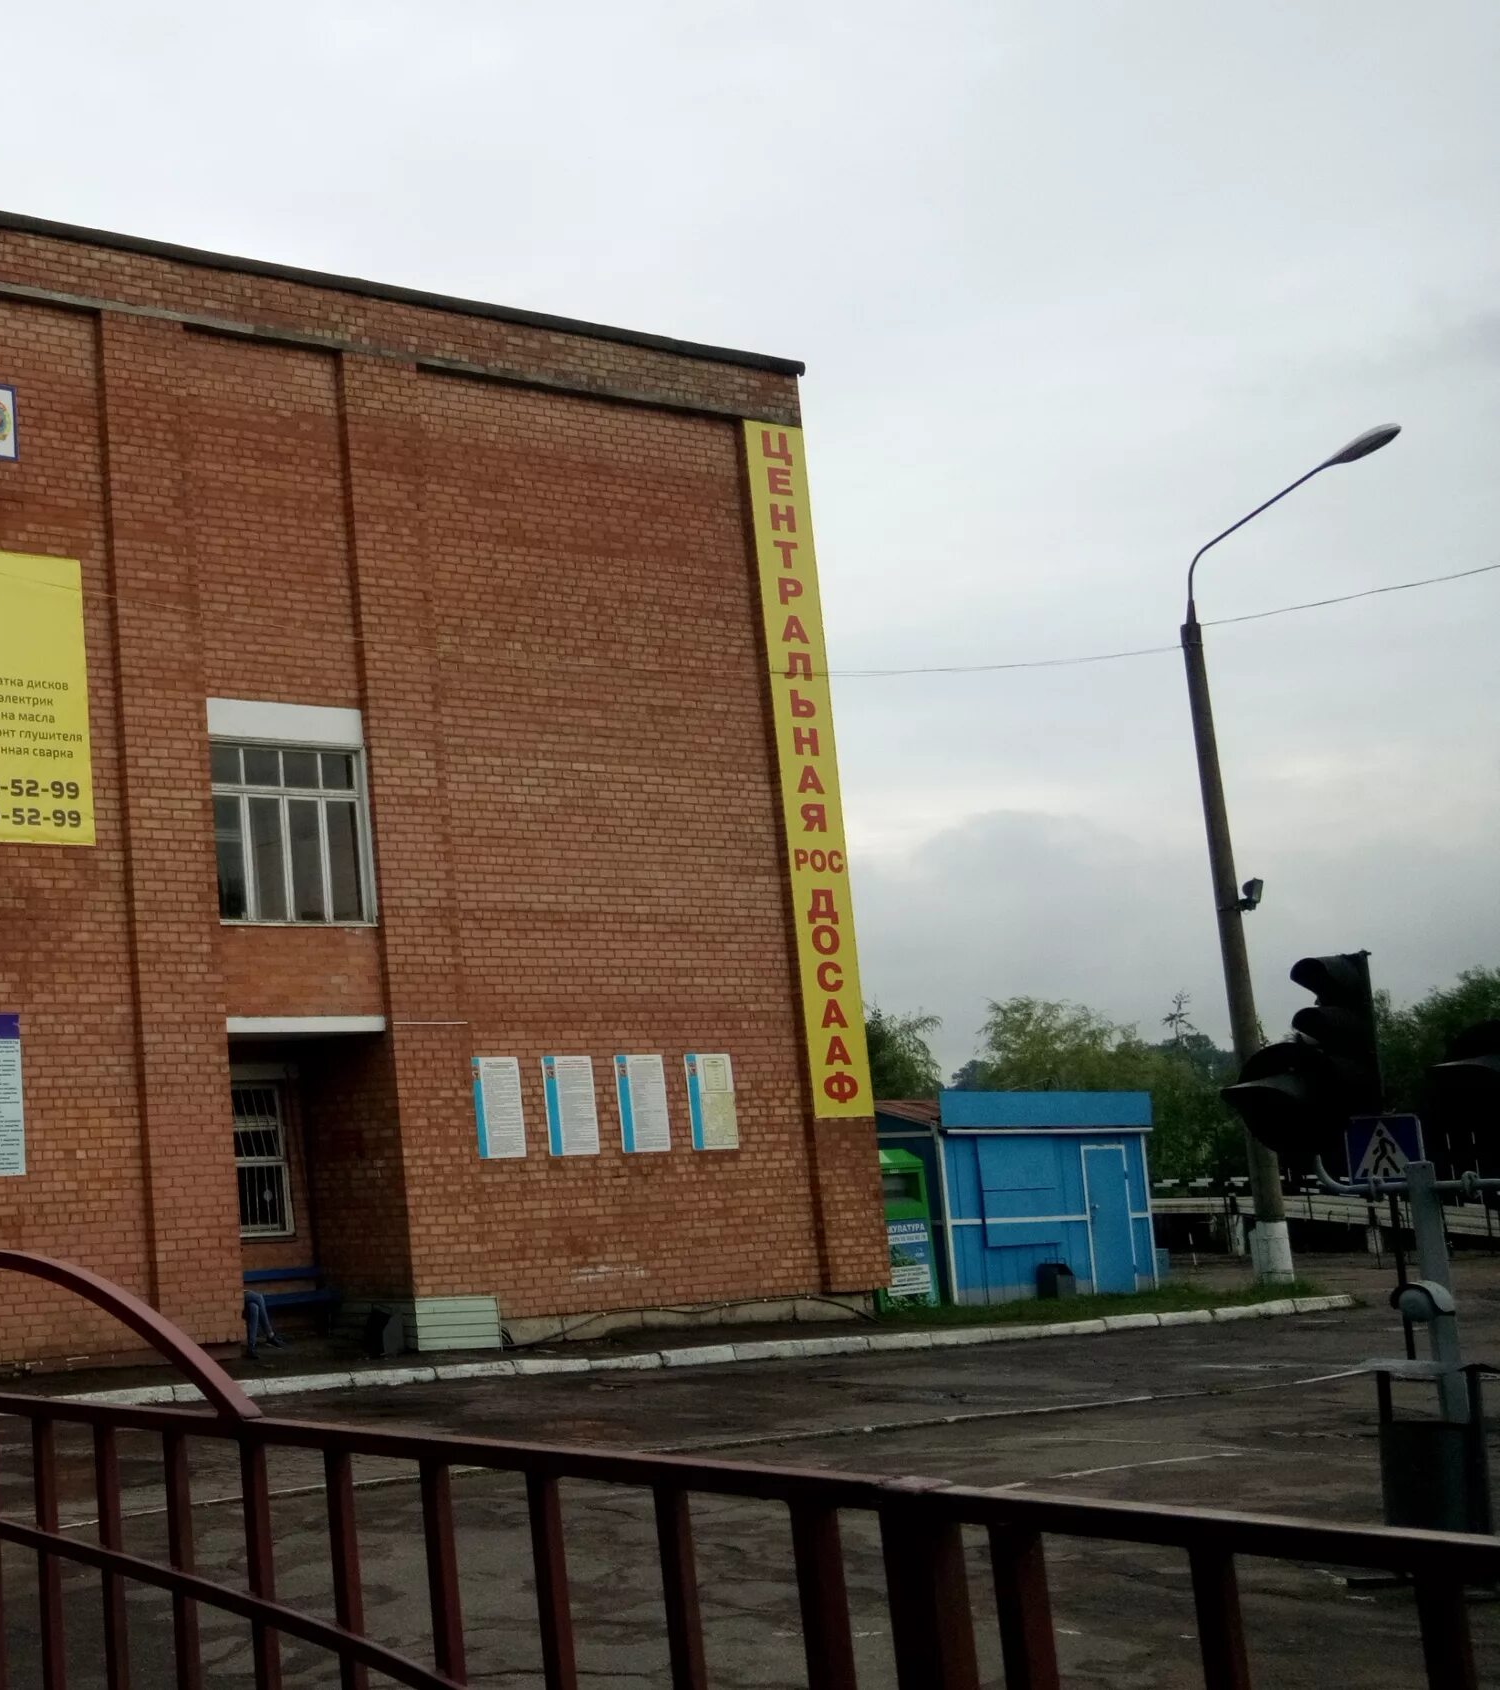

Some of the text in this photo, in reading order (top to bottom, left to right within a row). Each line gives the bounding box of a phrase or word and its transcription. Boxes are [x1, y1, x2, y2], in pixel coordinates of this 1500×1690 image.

[761, 430, 828, 833] ЦЕНТРАЛЬНАЯ
[26, 679, 69, 691] дисков
[18, 712, 56, 724] масла
[19, 729, 83, 743] глушителя
[32, 747, 74, 760] сварка
[794, 848, 844, 874] РОС
[807, 888, 859, 1104] ДОСААФ
